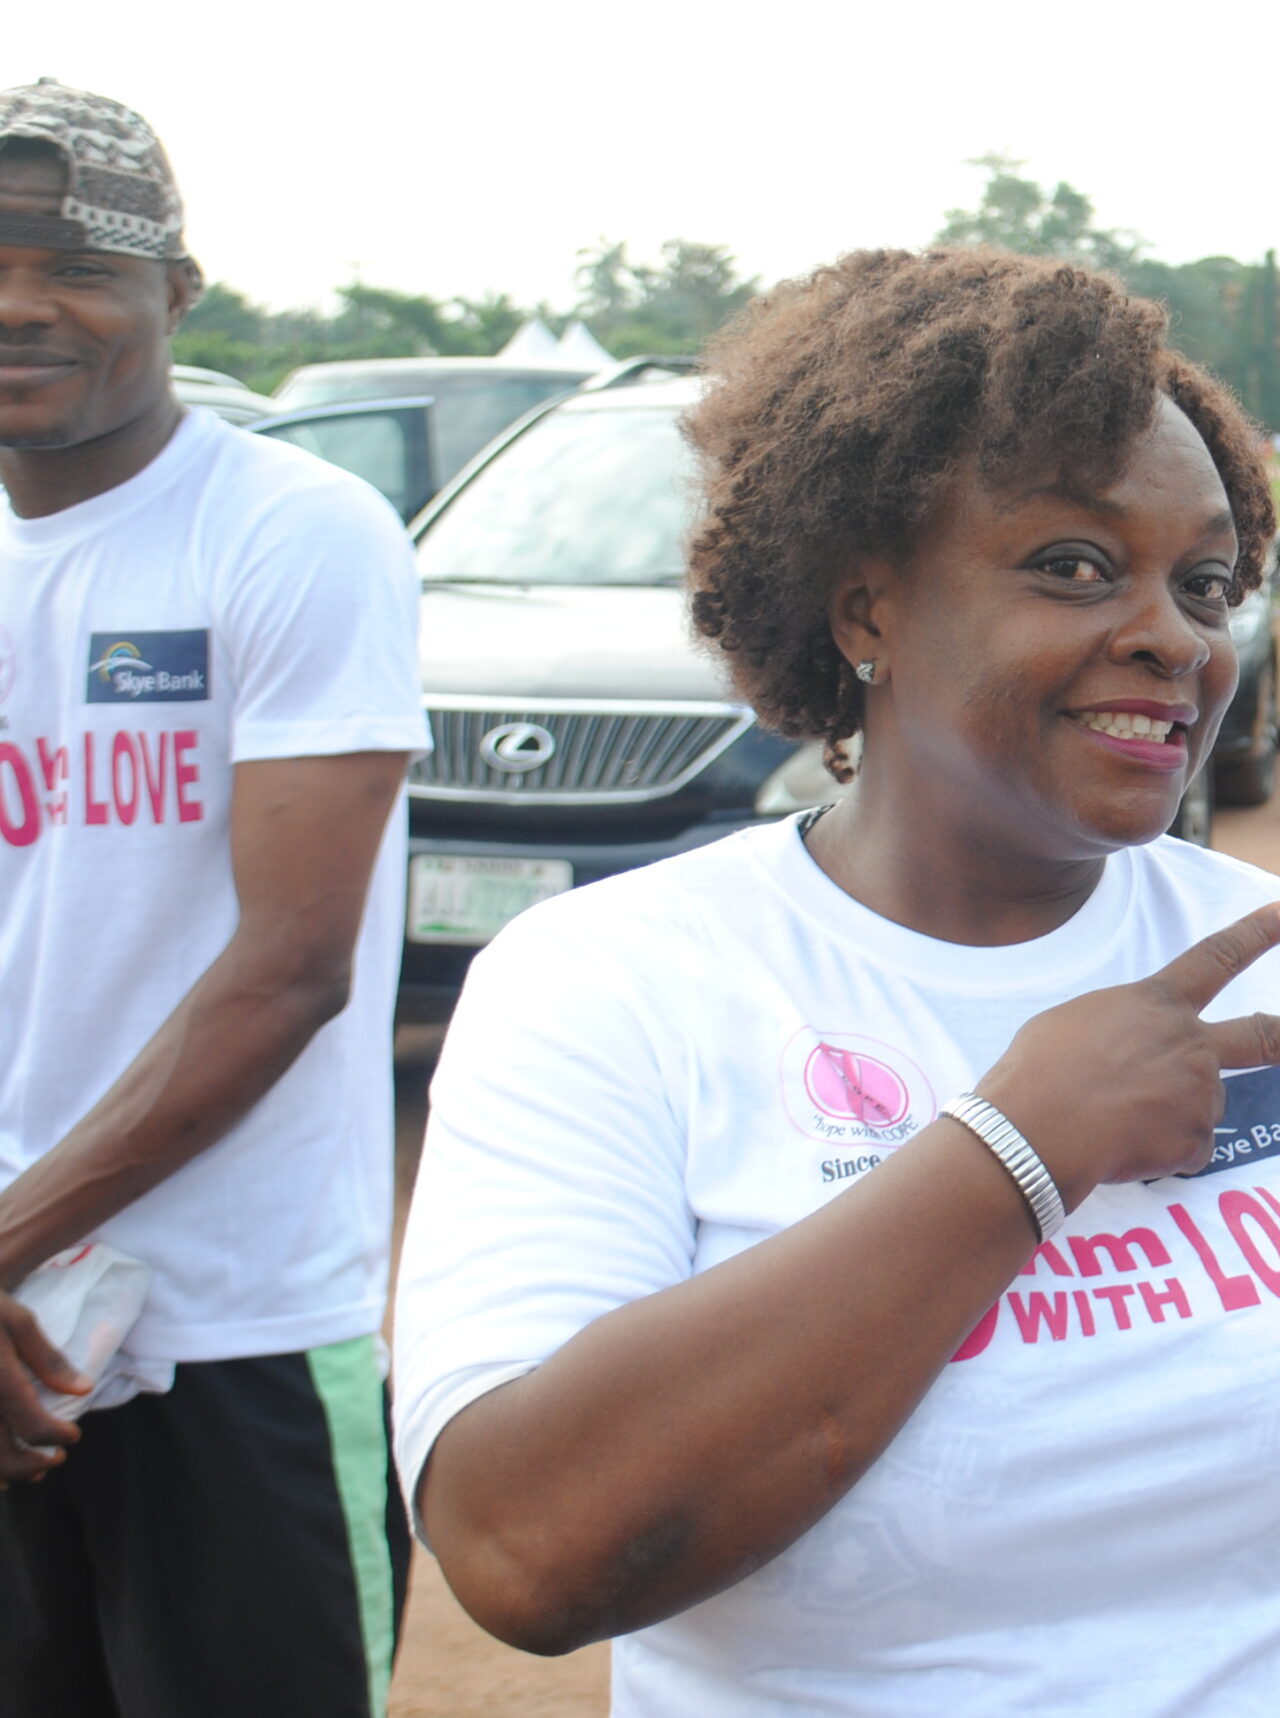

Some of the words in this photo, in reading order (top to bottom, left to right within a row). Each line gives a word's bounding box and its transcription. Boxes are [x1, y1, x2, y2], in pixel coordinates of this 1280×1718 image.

[113, 670, 156, 698] Skye
[156, 669, 205, 693] Bank
[84, 728, 205, 827] LOVE
[1210, 1138, 1253, 1163] kye
[820, 1154, 881, 1183] Since
[1006, 1277, 1193, 1344] WITH
